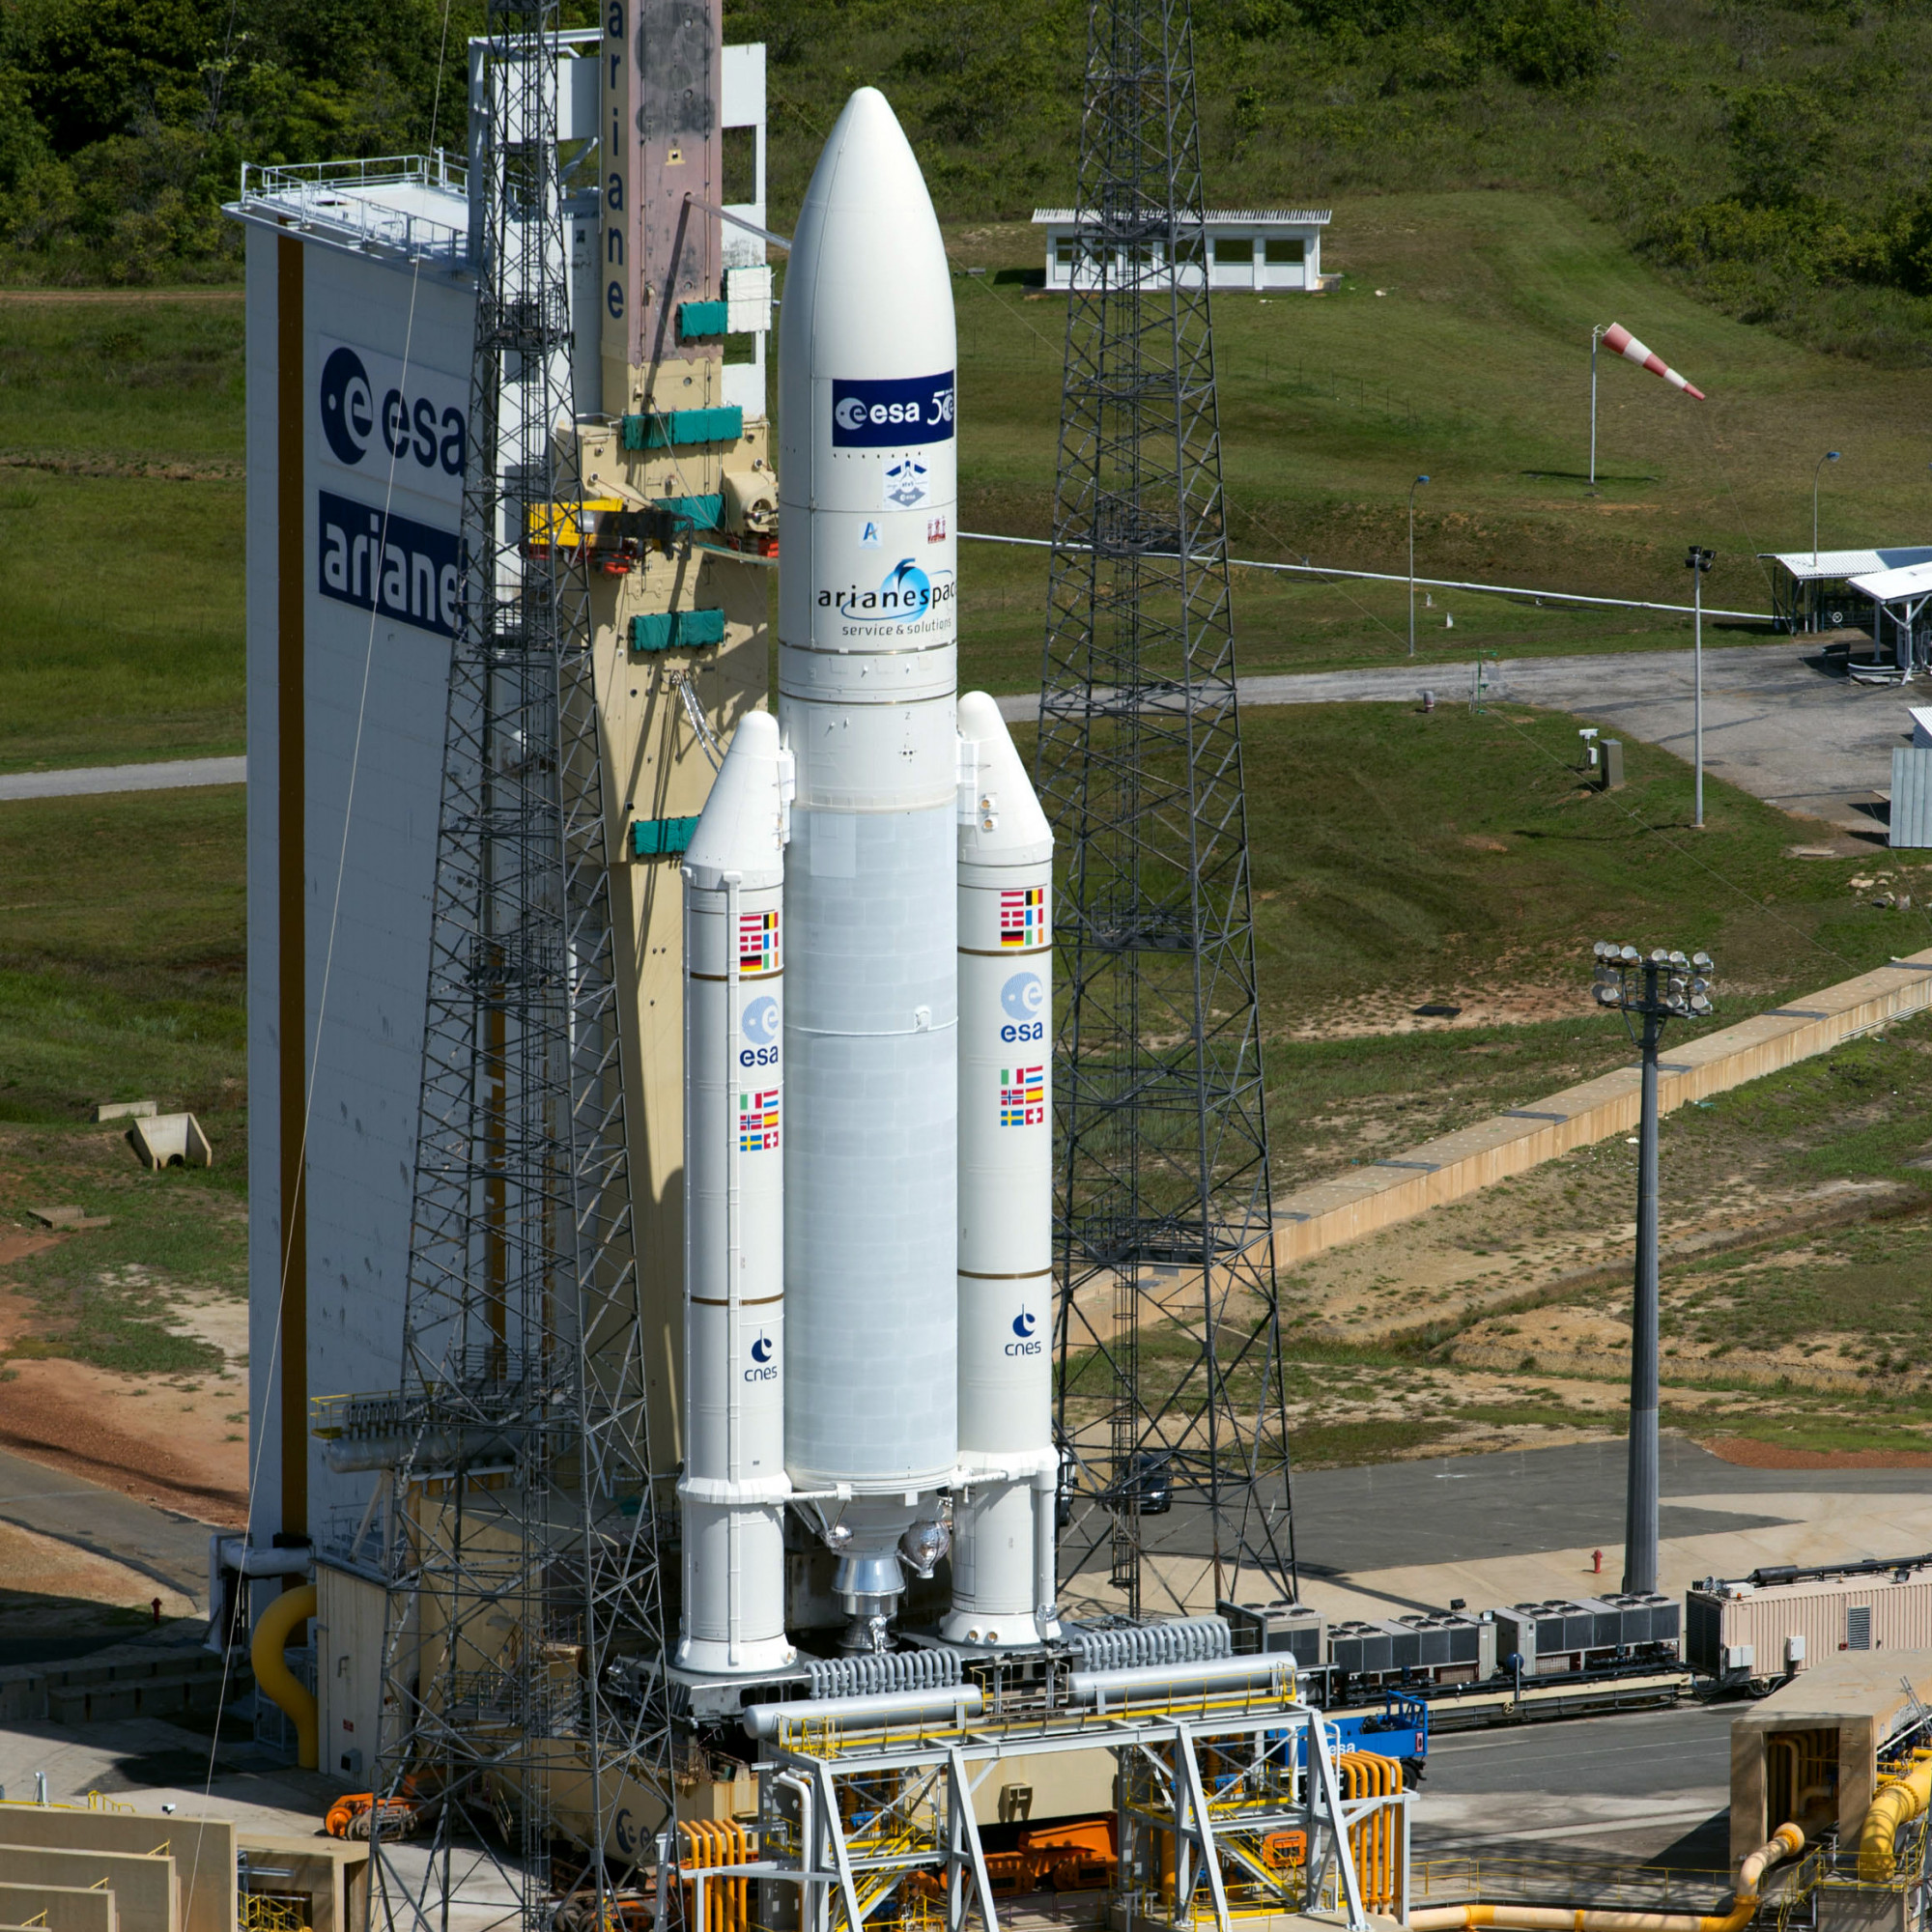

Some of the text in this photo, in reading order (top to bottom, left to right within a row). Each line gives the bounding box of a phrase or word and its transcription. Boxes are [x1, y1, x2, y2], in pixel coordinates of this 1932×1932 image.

[869, 402, 920, 424] esa
[382, 388, 466, 477] esa
[842, 617, 952, 636] service & solutions
[1001, 1022, 1043, 1043] esa
[740, 1045, 779, 1067] esa
[1005, 1340, 1041, 1356] cnes
[744, 1365, 778, 1382] cnes
